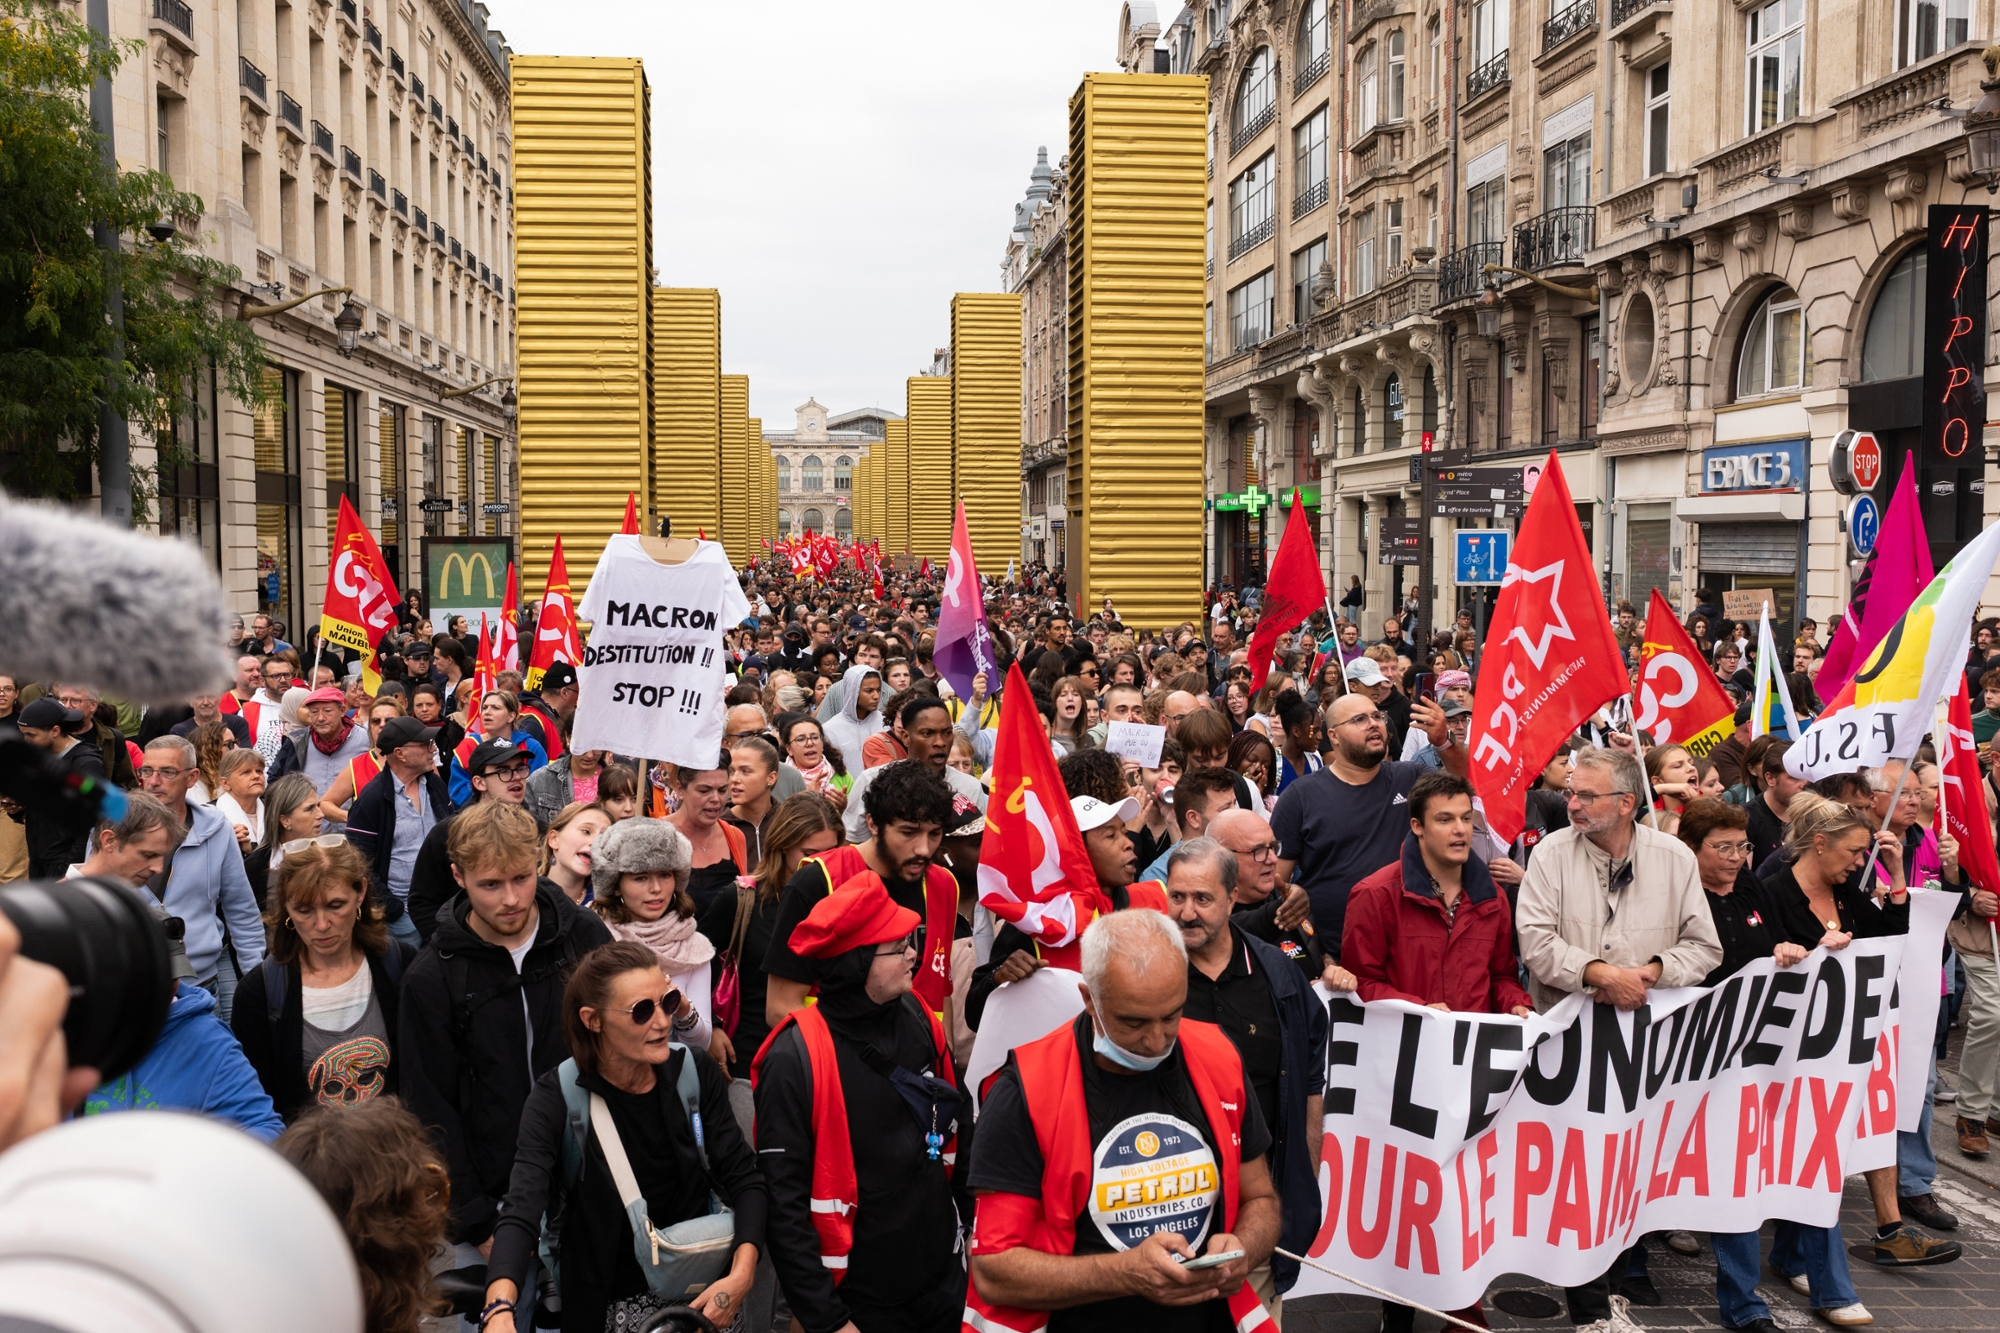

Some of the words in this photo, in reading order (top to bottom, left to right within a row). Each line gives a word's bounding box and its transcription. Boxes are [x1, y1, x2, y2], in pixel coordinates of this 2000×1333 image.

[1942, 213, 1980, 457] HIPPO
[1707, 453, 1773, 489] ESPACE
[1775, 451, 1790, 486] 3
[1855, 454, 1877, 470] STOP
[425, 503, 451, 511] Cuisine
[607, 600, 718, 631] MACRON
[329, 630, 371, 650] MAUBE
[336, 624, 362, 637] Union
[612, 682, 675, 708] STOP
[679, 689, 701, 715] !!!
[1117, 727, 1151, 737] MACRON
[1324, 997, 1365, 1115] E
[1132, 1116, 1143, 1124] THE
[1144, 1114, 1169, 1122] HIGHEST
[1118, 1145, 1133, 1155] EST.
[1163, 1135, 1181, 1146] 1973
[1120, 1164, 1144, 1178] HIGH
[1147, 1156, 1190, 1173] VOLTAGE
[1306, 1131, 1443, 1275] OUR
[1455, 1128, 1498, 1272] LE
[1645, 1090, 1710, 1205] LA
[1733, 1076, 1853, 1198] PAIX
[1106, 1168, 1211, 1208] PETROL
[1128, 1226, 1150, 1239] LOS
[1154, 1216, 1199, 1232] ANGELES
